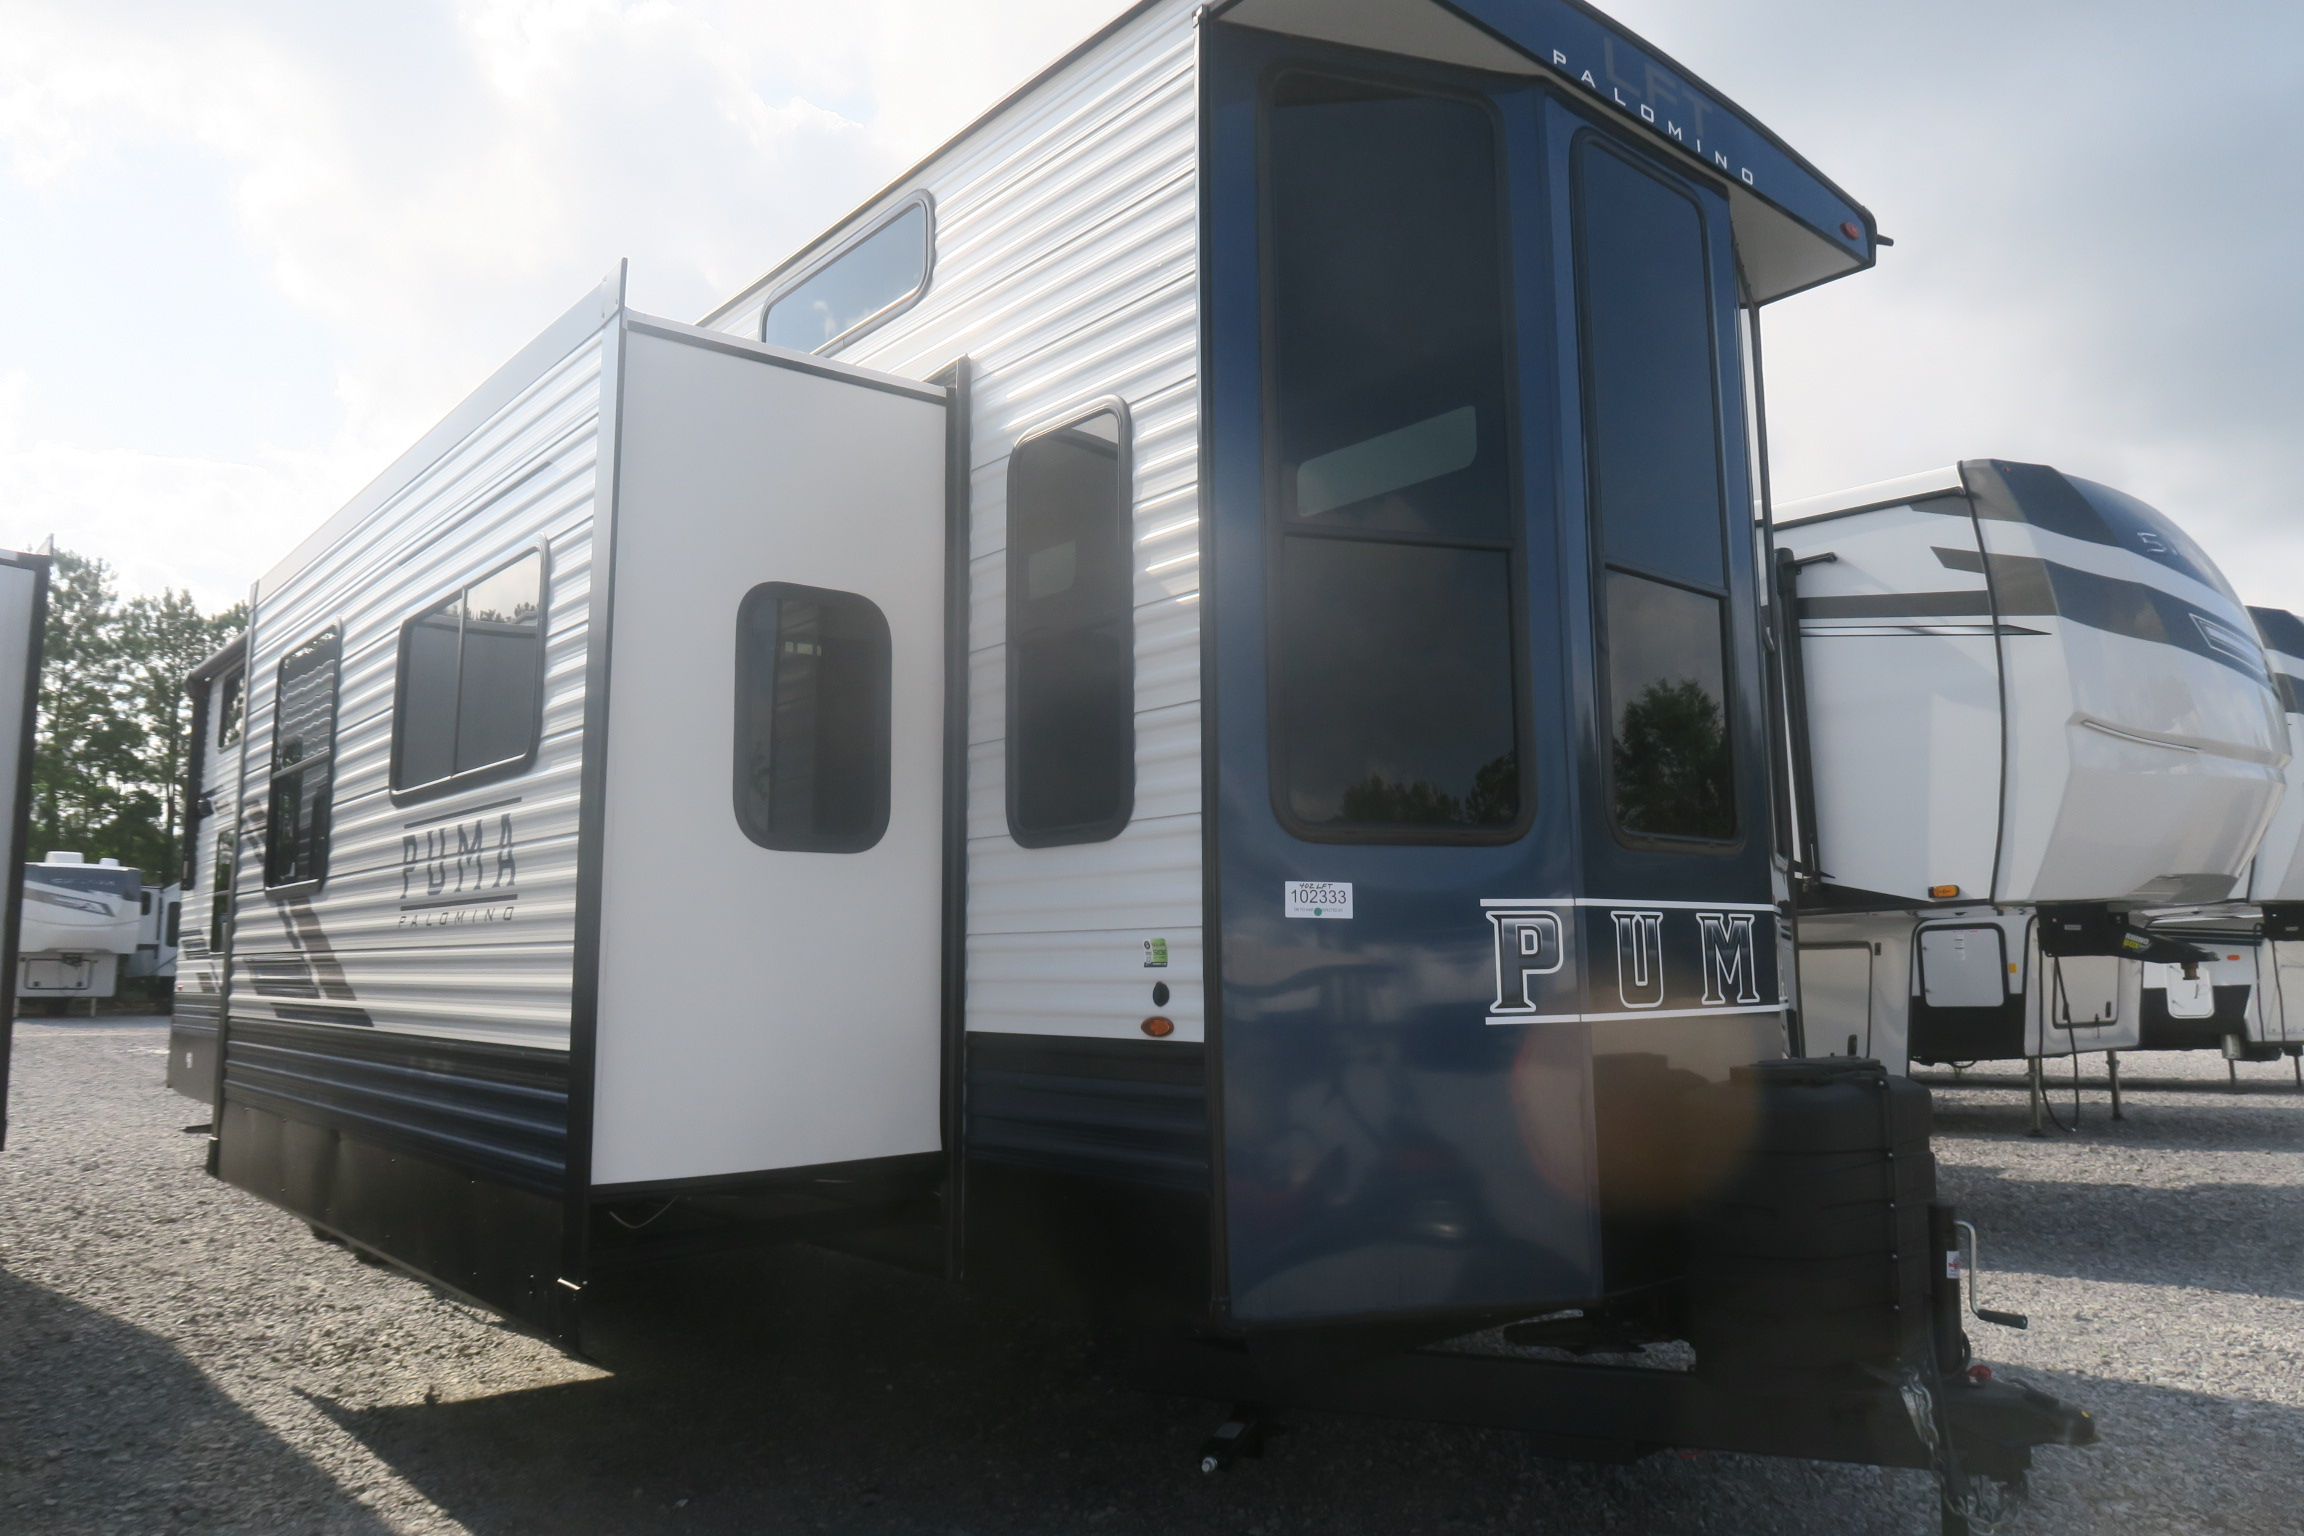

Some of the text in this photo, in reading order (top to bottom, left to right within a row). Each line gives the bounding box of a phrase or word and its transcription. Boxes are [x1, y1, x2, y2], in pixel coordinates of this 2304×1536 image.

[1553, 49, 1754, 186] PALOMINO
[1604, 36, 1713, 139] LFT
[400, 813, 515, 899] PUMA
[1291, 889, 1347, 904] 102333
[398, 906, 514, 928] PALOMINO
